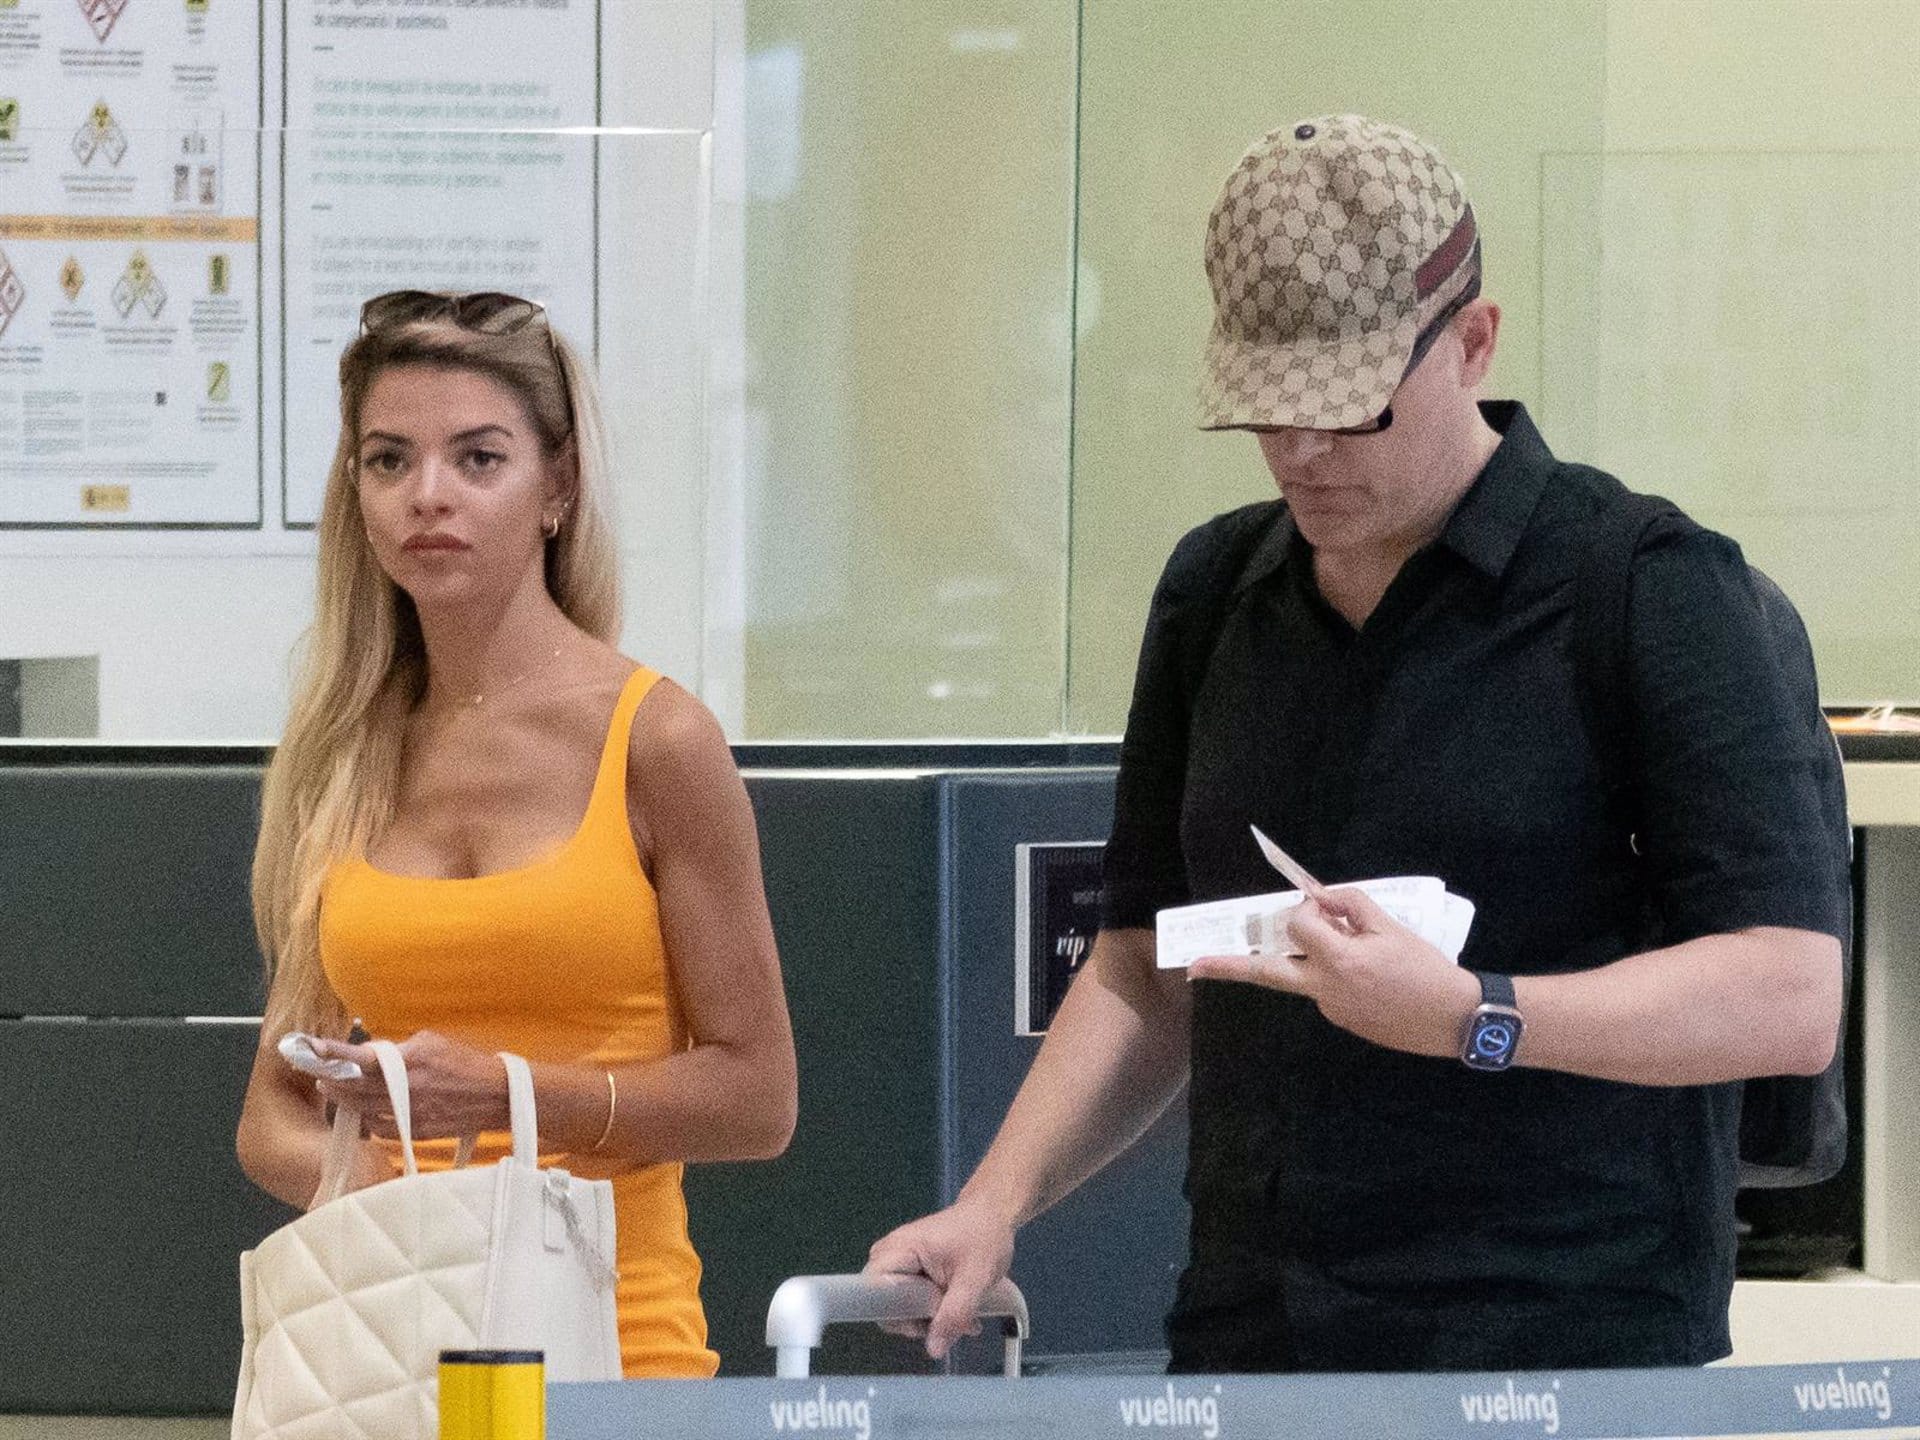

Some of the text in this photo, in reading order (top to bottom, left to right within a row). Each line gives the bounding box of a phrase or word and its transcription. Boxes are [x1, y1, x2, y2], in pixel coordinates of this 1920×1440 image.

[770, 1384, 875, 1440] vueling
[1120, 1382, 1222, 1438] vueling
[1460, 1378, 1560, 1434] vueling
[1794, 1366, 1892, 1420] vueling
